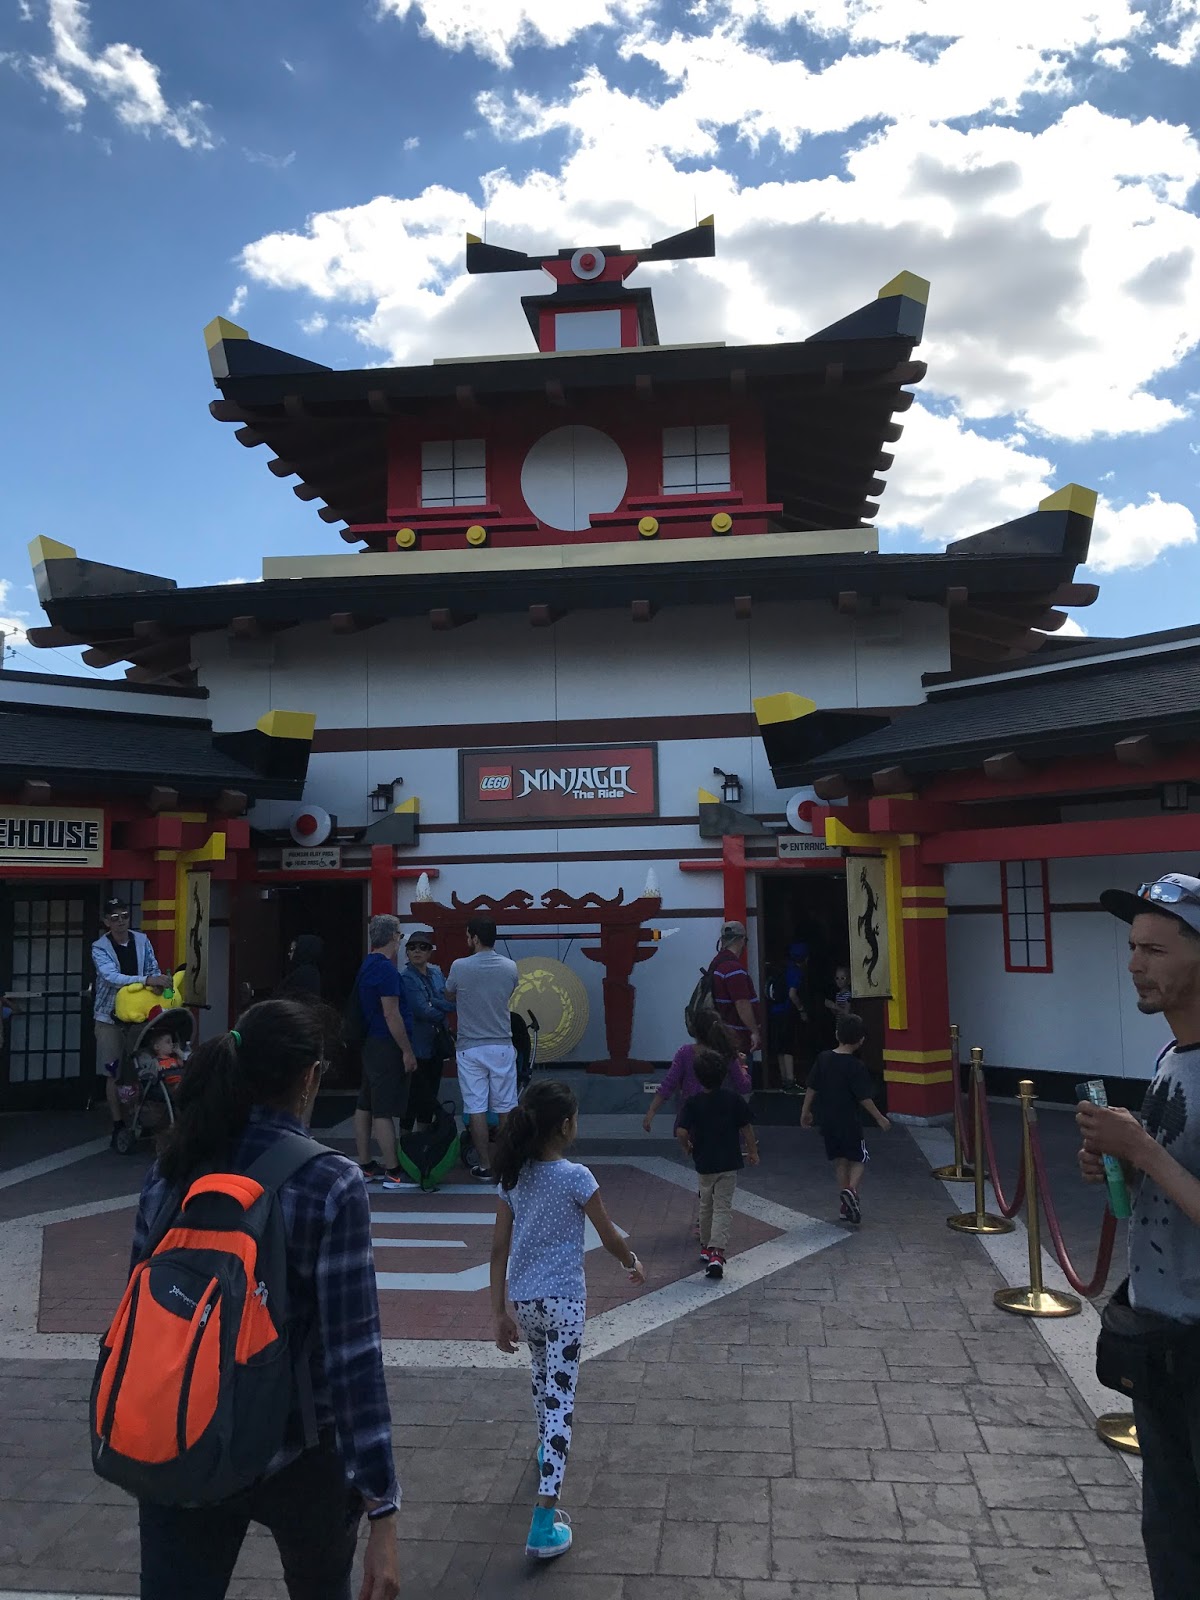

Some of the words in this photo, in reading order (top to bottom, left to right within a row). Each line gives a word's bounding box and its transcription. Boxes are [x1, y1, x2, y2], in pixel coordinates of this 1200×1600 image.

[480, 775, 511, 791] LEGO
[516, 766, 638, 798] NINJAGO
[572, 790, 594, 799] The
[598, 789, 624, 798] Ride
[790, 842, 829, 851] ENTRANCE
